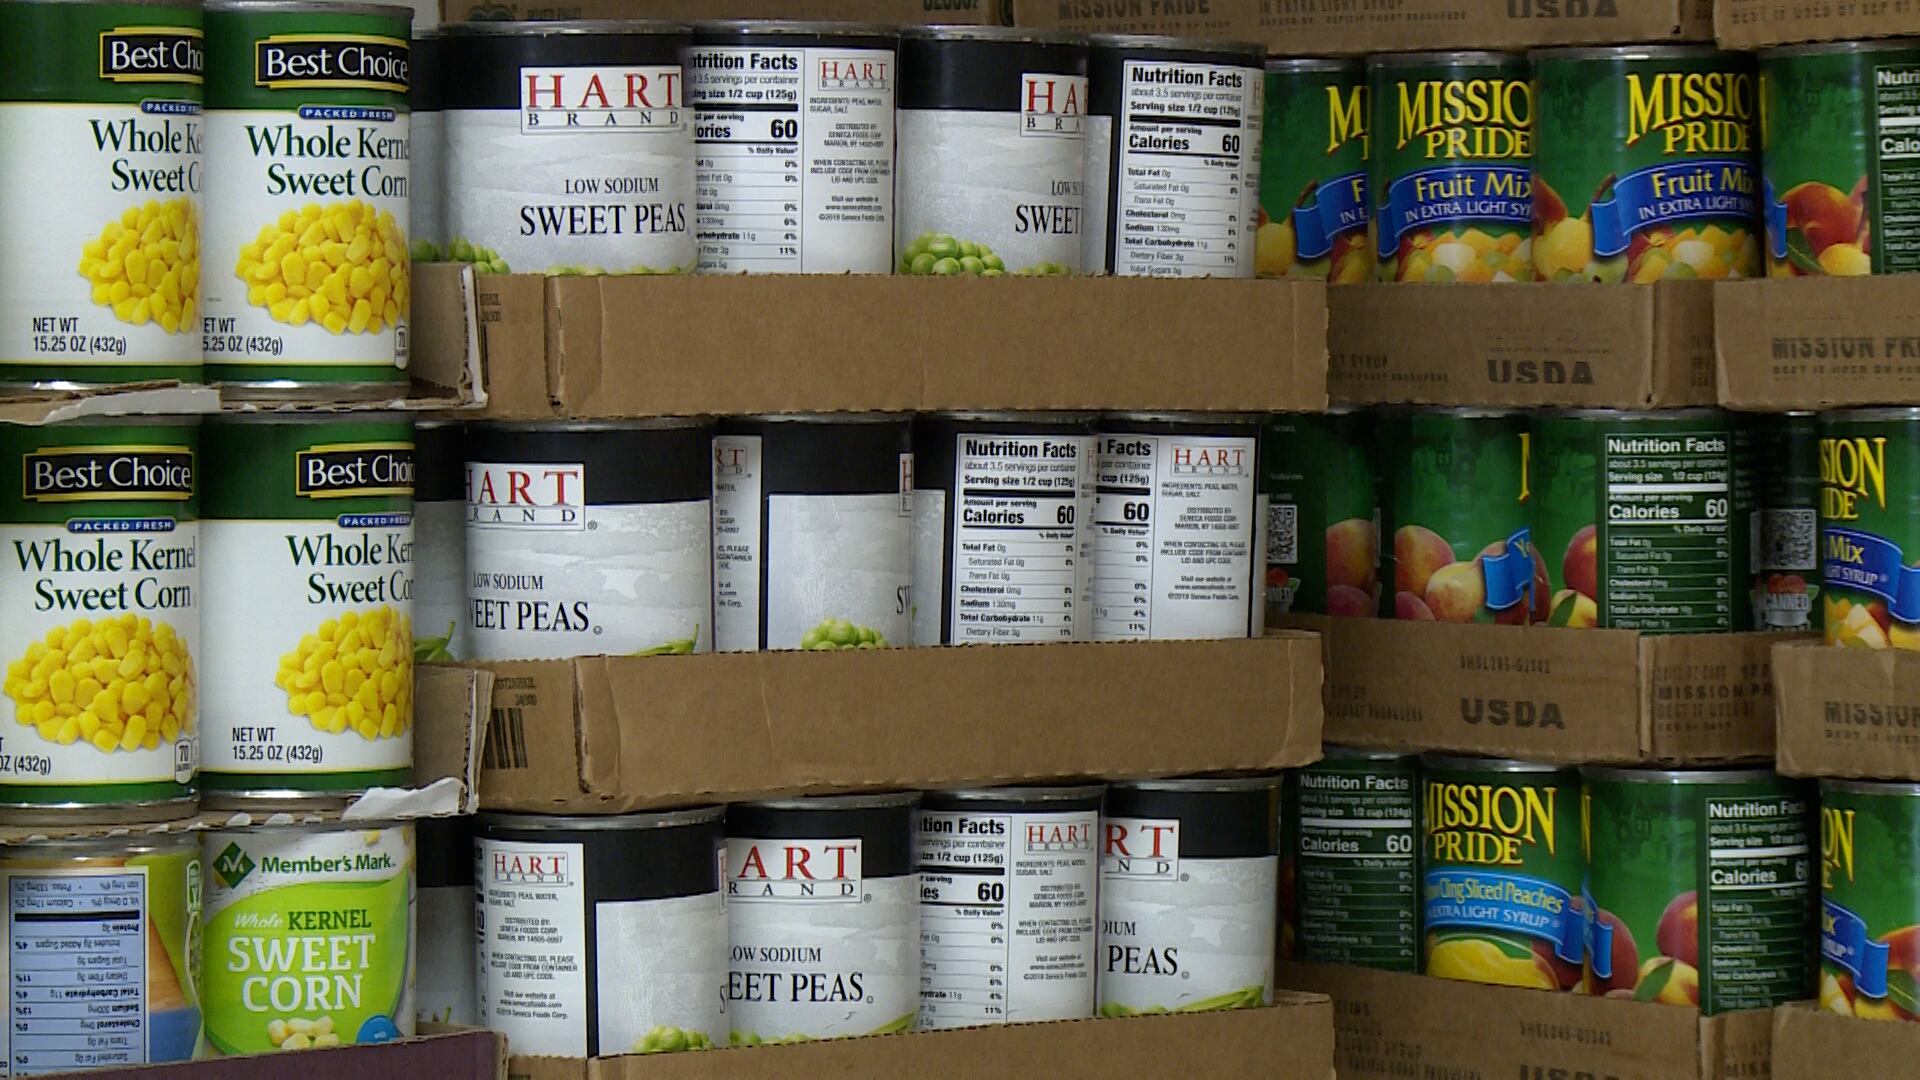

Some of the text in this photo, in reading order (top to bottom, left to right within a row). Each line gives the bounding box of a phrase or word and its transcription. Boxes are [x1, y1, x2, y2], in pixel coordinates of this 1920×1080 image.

[1507, 0, 1619, 18] USDA
[111, 40, 167, 71] Best
[266, 47, 408, 81] Best Choice
[750, 53, 798, 70] Facts
[821, 61, 887, 81] HART
[1132, 67, 1242, 88] Nutrition Facts
[1878, 70, 1920, 86] Nutri
[526, 73, 680, 108] HART
[728, 89, 744, 99] 1/2
[747, 89, 763, 100] cup
[766, 89, 797, 101] (125g)
[146, 102, 188, 113] PACKED
[304, 109, 394, 120] PACKED FRESH
[1130, 101, 1218, 115] Serving size 1/2 cup
[1396, 80, 1532, 150] MISSIO
[1626, 73, 1752, 145] MISSIO
[527, 110, 679, 127] BRAND
[89, 119, 182, 154] Whole
[770, 119, 798, 139] 60
[1663, 120, 1751, 154] PRIDE
[244, 124, 351, 159] Whole
[1129, 134, 1240, 154] Calories 60
[1425, 126, 1532, 158] PRIDE
[1880, 138, 1920, 153] Calo
[110, 158, 185, 193] Sweet
[266, 163, 408, 199] Sweet Corn
[565, 177, 660, 194] LOW SODIUM
[1652, 170, 1714, 198] Fruit
[1051, 179, 1073, 195] LOW
[1416, 176, 1476, 202] Fruit
[520, 202, 685, 236] SWEET PEAS
[1015, 204, 1080, 234] SWEET
[1405, 202, 1506, 223] IN EXTRA LIGHT
[1638, 206, 1655, 220] IN
[1660, 198, 1701, 215] EXTRA
[33, 317, 79, 333] NET WT
[219, 318, 236, 333] WT
[33, 336, 127, 356] 15.25 OZ (432g)
[228, 336, 283, 356] OZ (432g)
[1771, 342, 1875, 360] MISSION
[1487, 359, 1596, 385] USDA
[966, 440, 1076, 458] Nutrition Facts
[1107, 439, 1151, 456] Facts
[1608, 437, 1726, 453] Nutrition Facts
[1174, 448, 1245, 466] HART
[34, 457, 192, 491] Best Choice
[307, 457, 368, 487] Best
[964, 475, 1052, 487] Serving size 1/2 cup
[1102, 474, 1118, 484] cup
[1608, 472, 1663, 484] Serving size
[1010, 500, 1038, 509] serving
[1123, 502, 1150, 522] 60
[1609, 499, 1728, 519] Calories 60
[73, 519, 172, 531] PACKED FRESH
[343, 517, 388, 527] PACKED
[963, 505, 1075, 525] Calories 60
[14, 536, 196, 572] Whole Kernel
[285, 534, 382, 568] Whole
[1829, 535, 1865, 564] Mix
[307, 572, 386, 605] Sweet
[473, 573, 544, 590] LOW SODIUM
[34, 577, 191, 612] Sweet Corn
[516, 600, 590, 632] PEAS
[1460, 697, 1567, 731] USDA
[232, 727, 276, 743] NET WT
[179, 744, 190, 763] 70
[232, 745, 323, 765] 15.25 OZ (432g)
[15, 755, 52, 776] (432g)
[1301, 775, 1409, 791] Nutrition Facts
[1709, 802, 1777, 818] Nutrition
[958, 819, 1005, 834] Facts
[1027, 825, 1091, 844] HART
[1302, 835, 1412, 853] Calories 60
[1434, 831, 1523, 865] PRIDE
[261, 852, 393, 875] Member's Mark
[494, 853, 566, 874] HART
[738, 844, 857, 879] ART
[937, 852, 1003, 864] 1/2 cup (125g)
[1711, 869, 1777, 884] Calories
[729, 883, 854, 896] RAND
[977, 883, 1004, 902] 60
[1466, 878, 1564, 914] Sliced Peaches
[233, 908, 372, 931] Whole KERNEL
[1463, 906, 1550, 928] LIGHT SYRUP
[227, 934, 375, 972] SWEET
[760, 947, 821, 962] SODIUM
[1107, 945, 1178, 976] PEAS
[242, 974, 364, 1013] CORN
[790, 972, 863, 1002] PEAS
